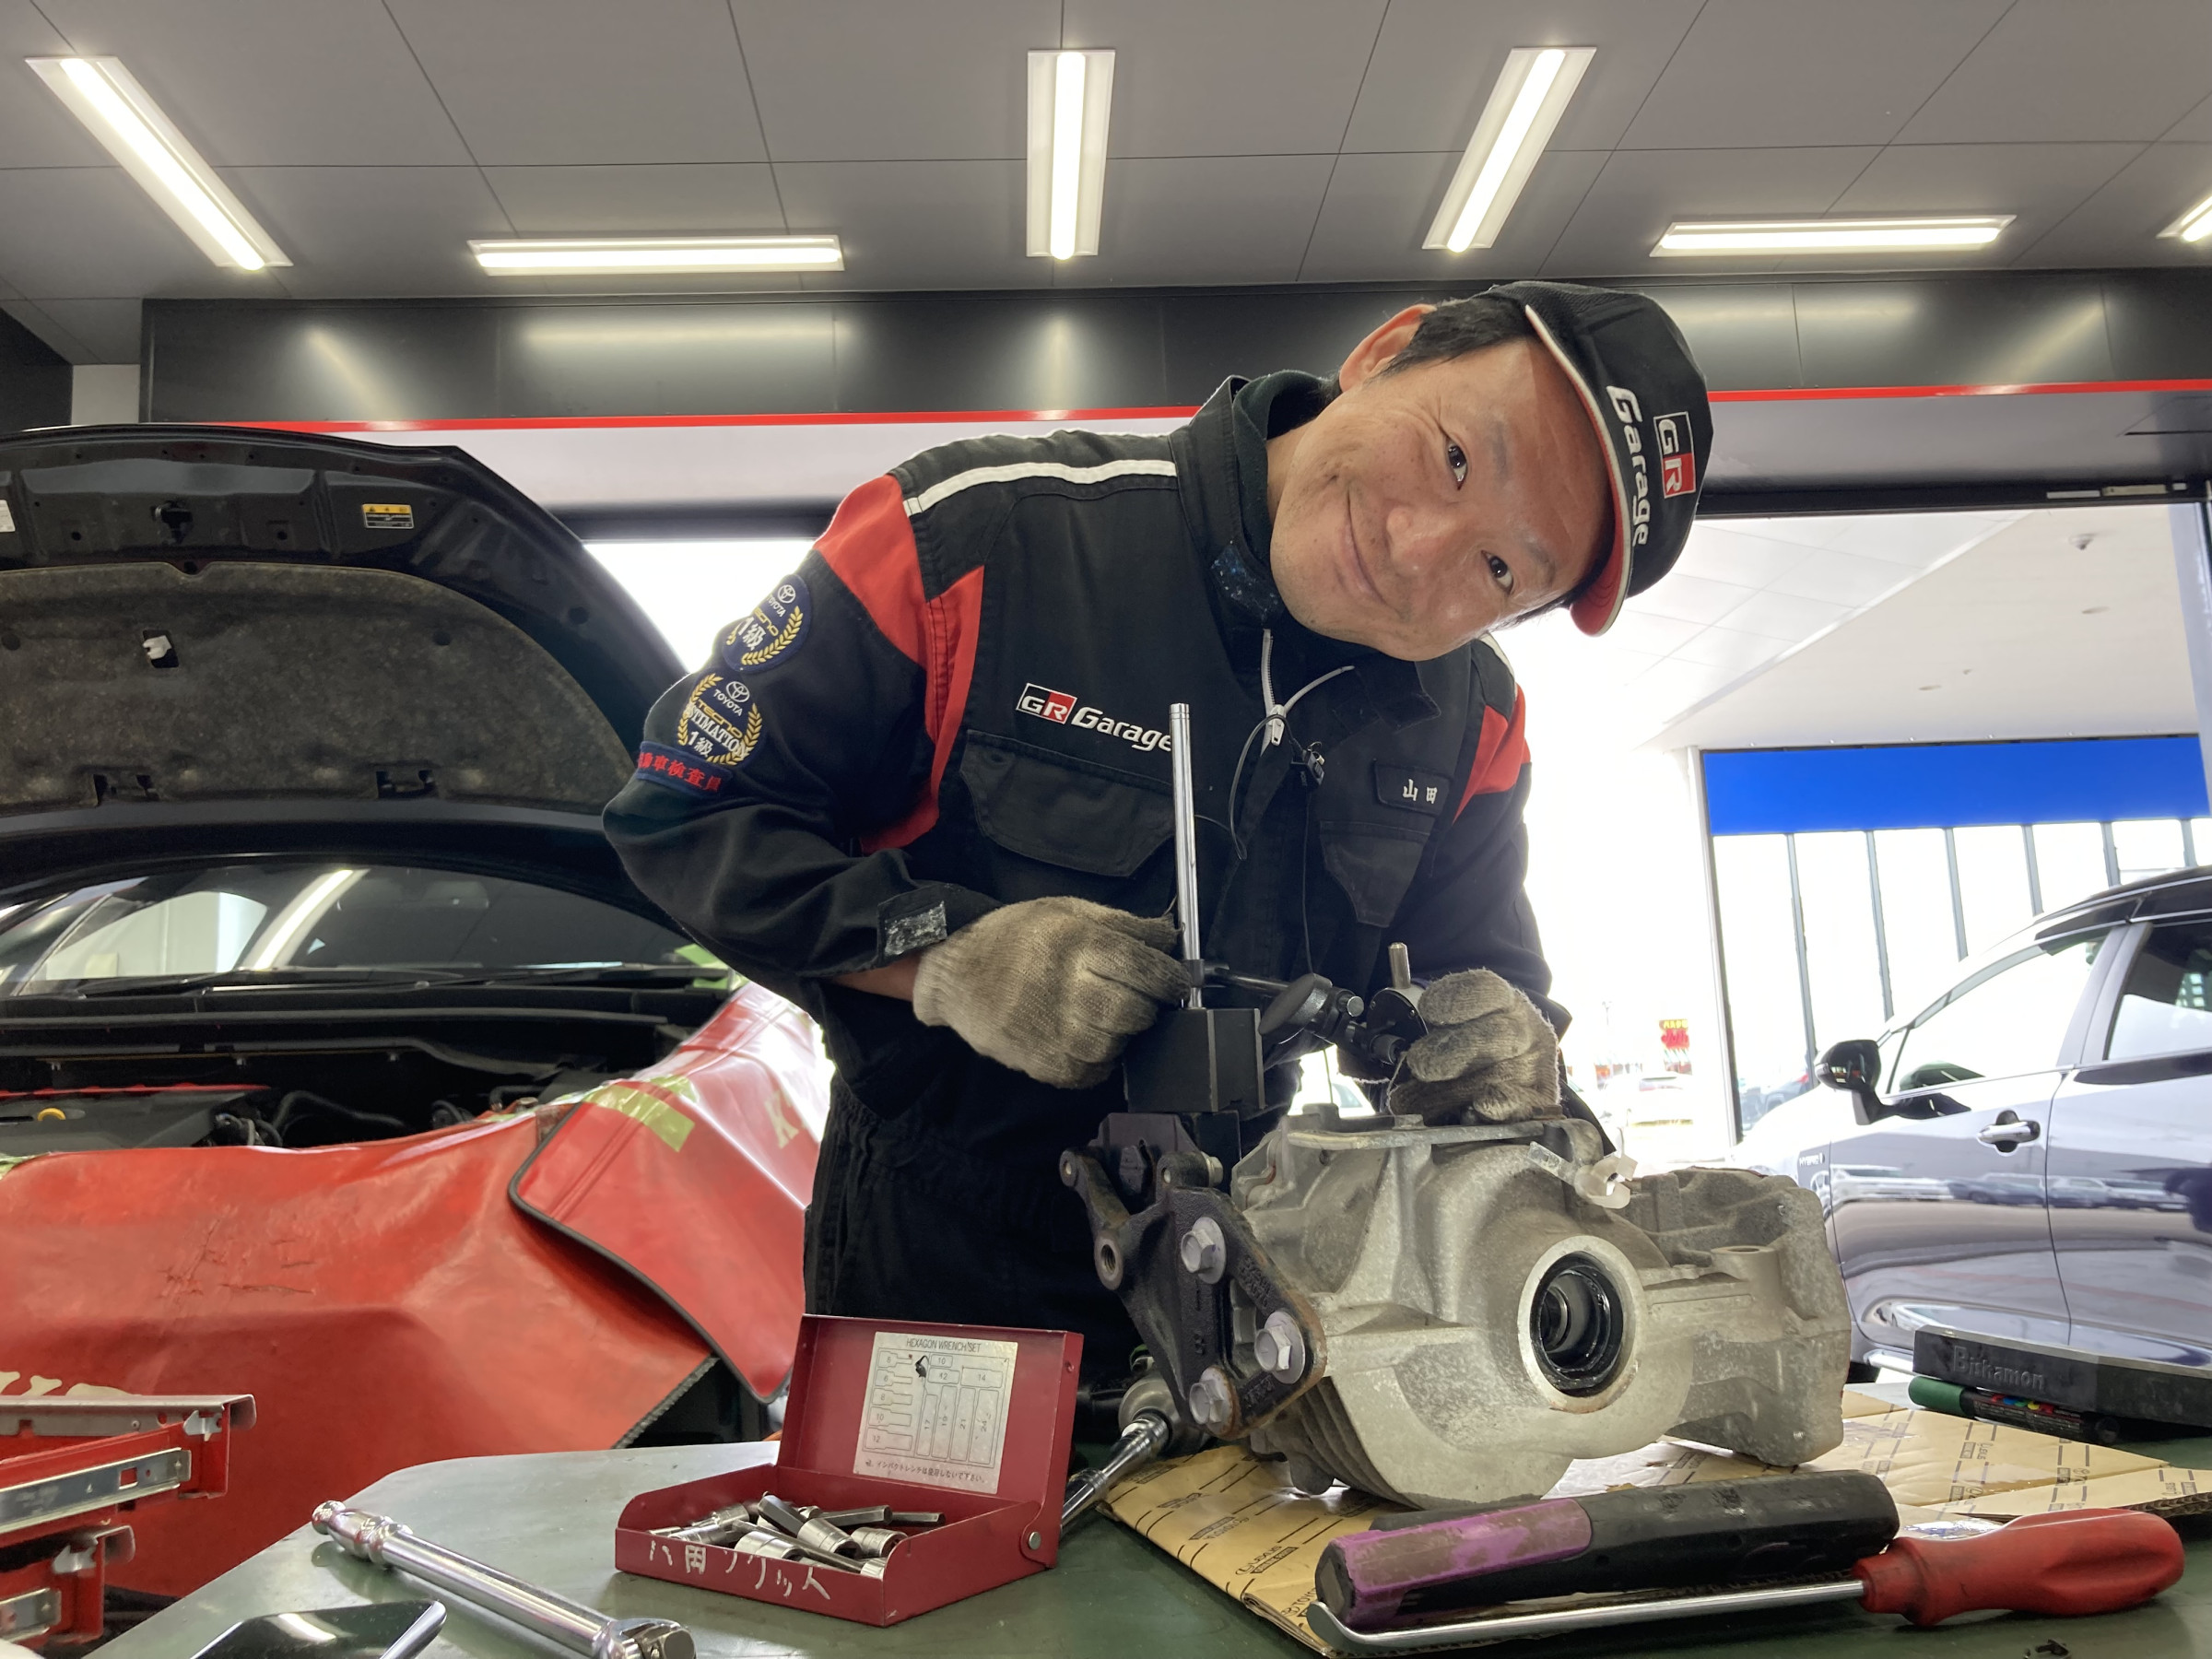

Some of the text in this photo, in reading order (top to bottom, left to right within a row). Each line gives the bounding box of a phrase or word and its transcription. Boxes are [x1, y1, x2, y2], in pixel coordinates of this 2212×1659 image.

[1606, 385, 1651, 547] Garage
[1659, 418, 1682, 493] GR
[754, 607, 779, 637] ECNO
[697, 700, 743, 738] TECNO
[712, 689, 743, 716] TOYOTA
[1021, 695, 1171, 751] GR Garage
[688, 730, 713, 758] 1級
[638, 751, 722, 793] 動車検査員
[1403, 778, 1438, 805] 山田
[907, 1338, 982, 1353] HEXAGON WRENCH SET
[938, 1357, 947, 1365] 10
[1954, 1346, 2045, 1390] Bishamon
